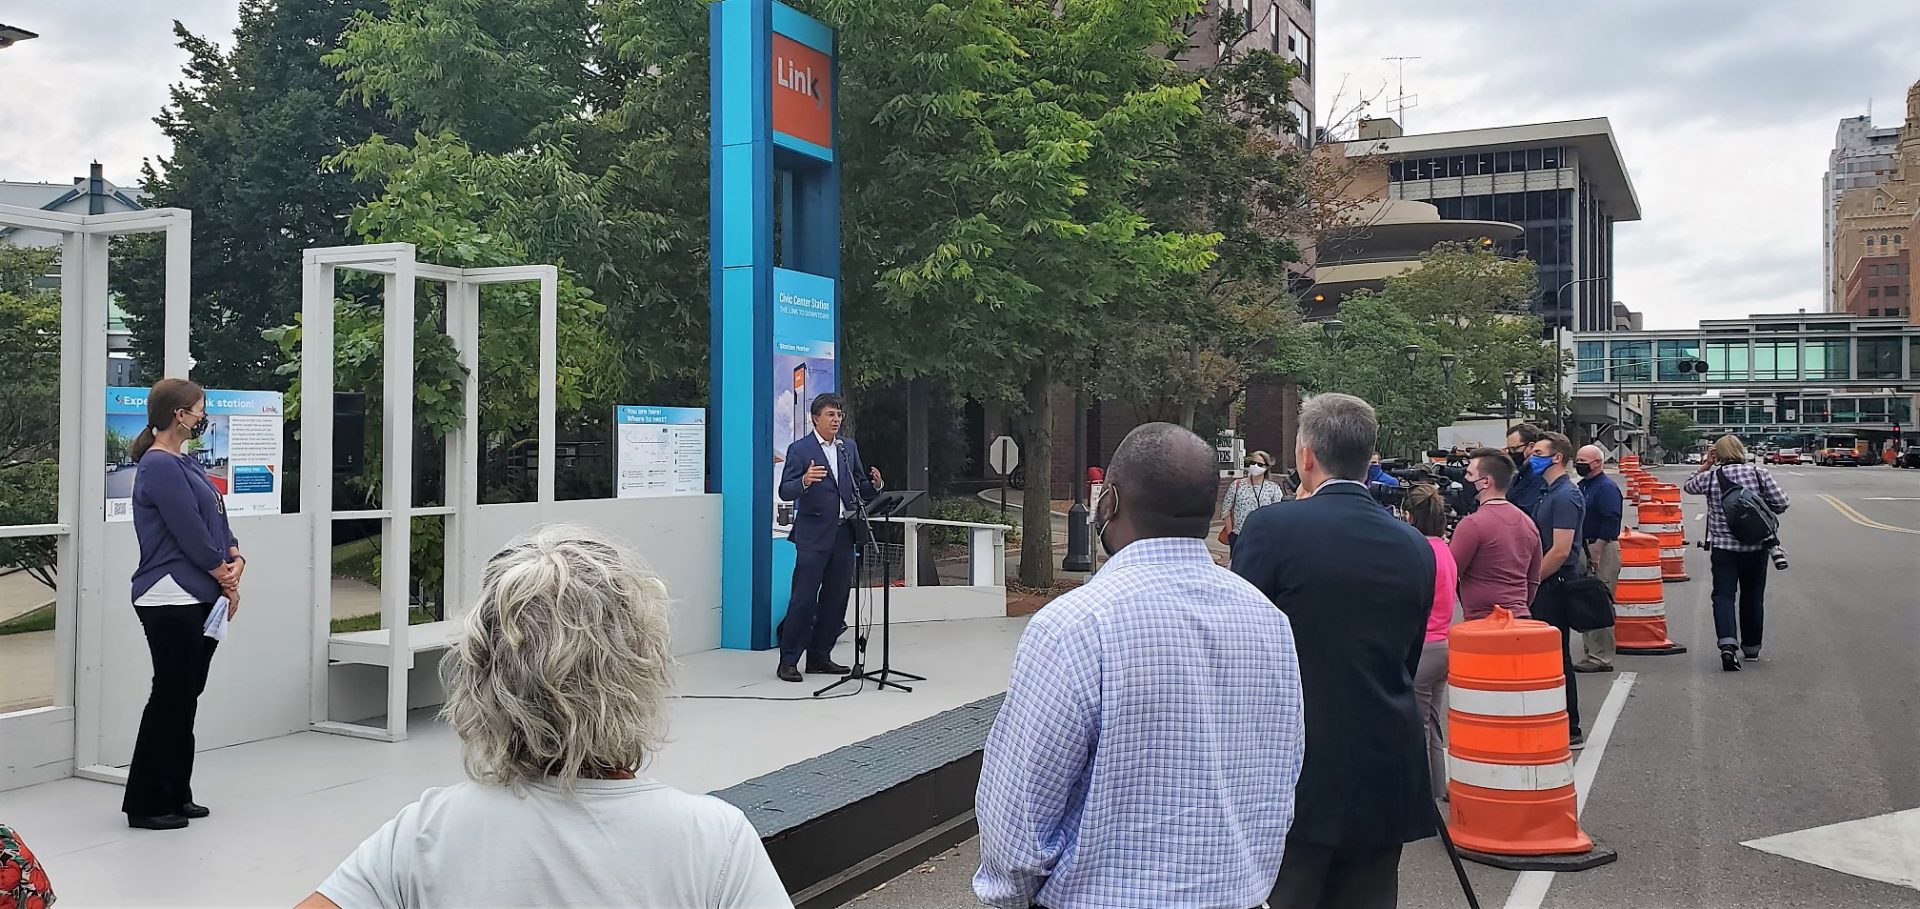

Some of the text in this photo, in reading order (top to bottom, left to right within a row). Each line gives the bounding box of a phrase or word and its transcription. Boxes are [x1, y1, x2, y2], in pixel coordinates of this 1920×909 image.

[779, 292, 830, 310] Civic Center Station
[627, 415, 645, 423] Where
